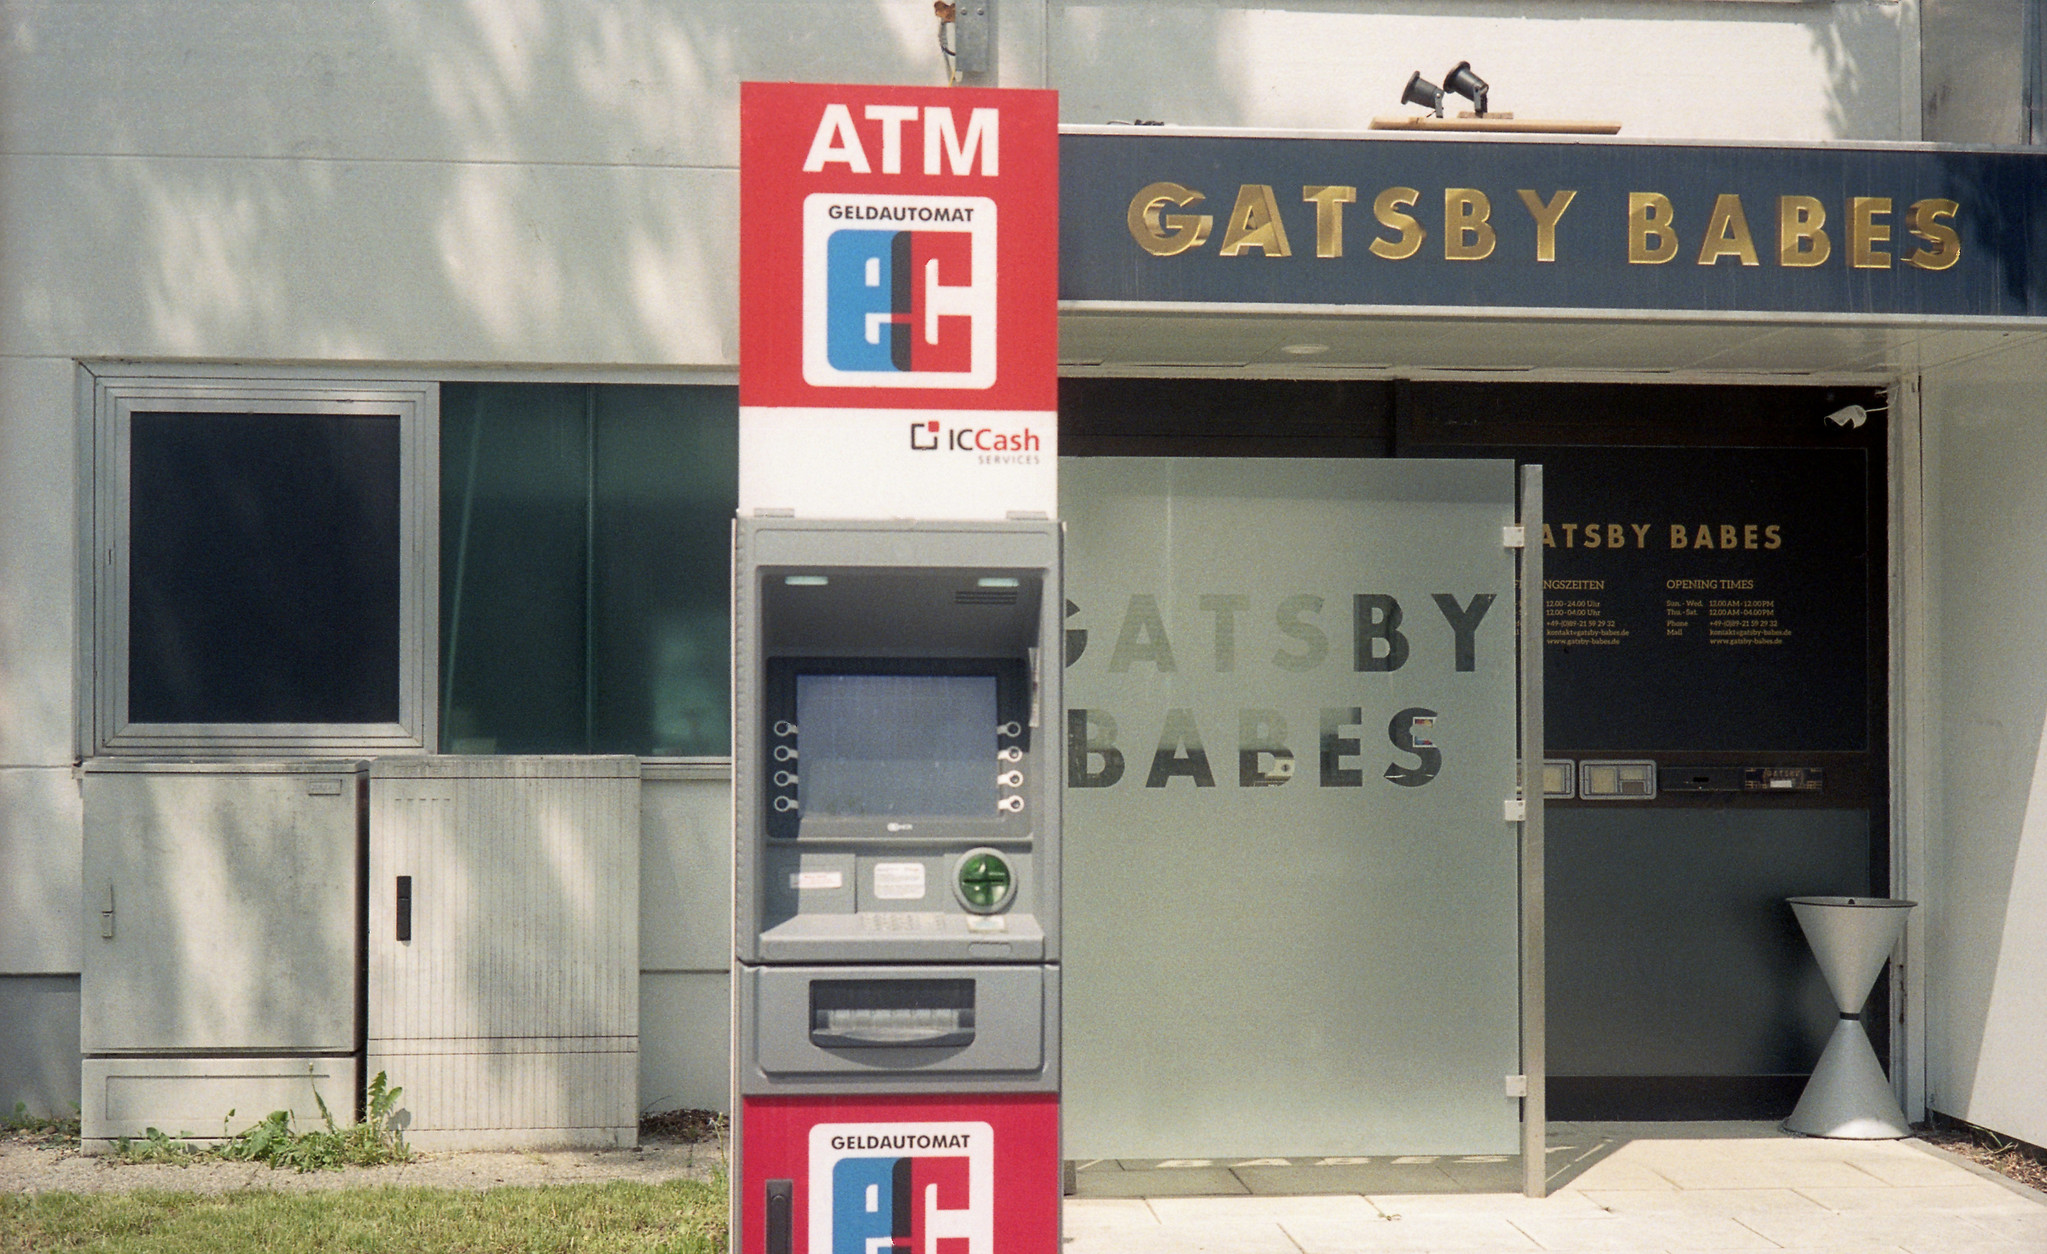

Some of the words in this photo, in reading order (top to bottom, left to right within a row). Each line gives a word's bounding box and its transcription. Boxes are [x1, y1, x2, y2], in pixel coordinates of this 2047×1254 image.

[802, 103, 999, 176] ATM
[828, 204, 975, 223] GELDAUTOMAT
[1126, 181, 1577, 262] GATSBY
[1628, 192, 1961, 270] BABES
[949, 428, 1040, 451] ICCash
[978, 454, 1041, 465] SERVICES
[1542, 523, 1651, 549] ATSBY
[1670, 524, 1782, 550] BABES
[1543, 580, 1605, 590] NGSZEITEN
[1666, 580, 1718, 590] OPENING
[1719, 580, 1754, 590] TIMES
[1067, 706, 1443, 789] BABES
[831, 1134, 971, 1150] GELDAUTOMAT
